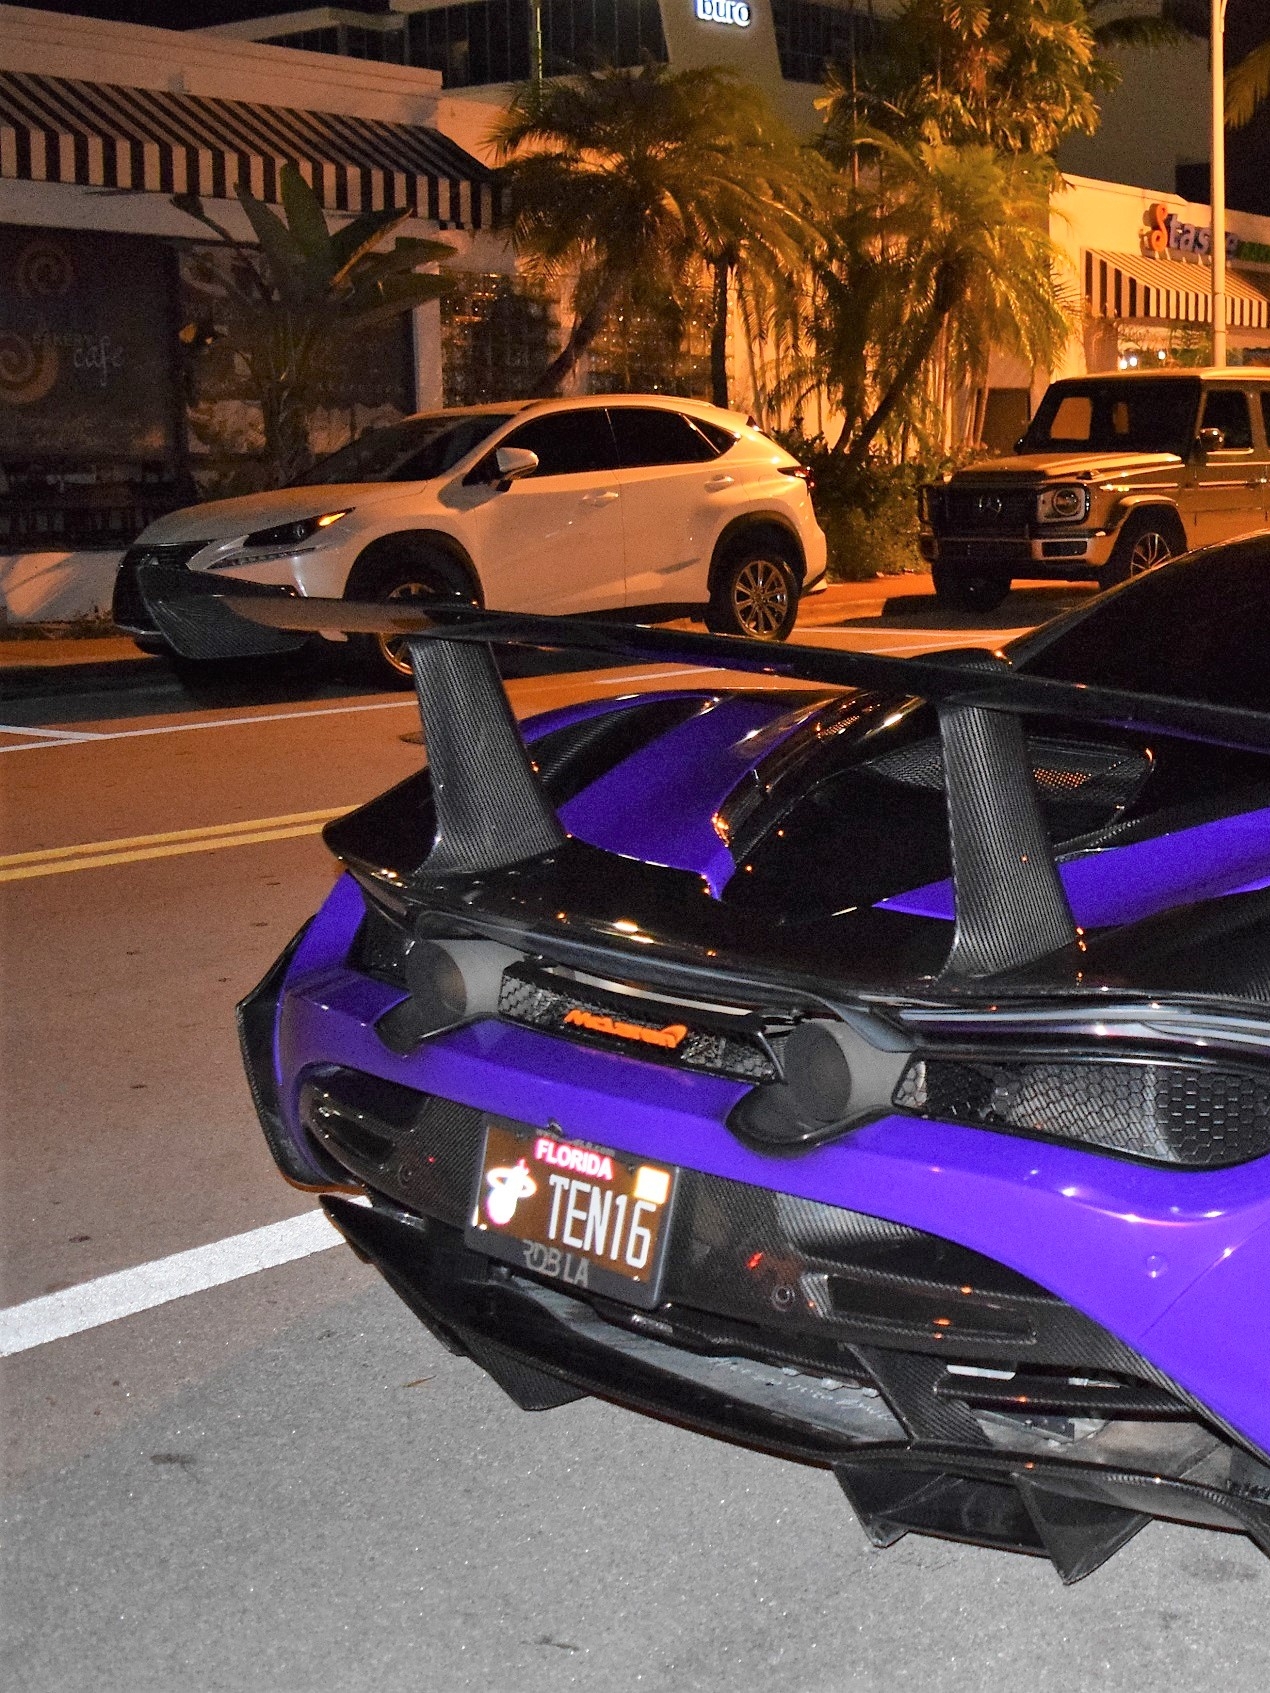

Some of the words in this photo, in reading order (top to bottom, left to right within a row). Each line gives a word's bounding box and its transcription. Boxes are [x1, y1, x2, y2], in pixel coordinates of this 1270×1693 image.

[694, 0, 751, 27] buro
[534, 1137, 614, 1181] FLORIDA
[548, 1173, 657, 1269] TEN16
[563, 1252, 590, 1288] LA
